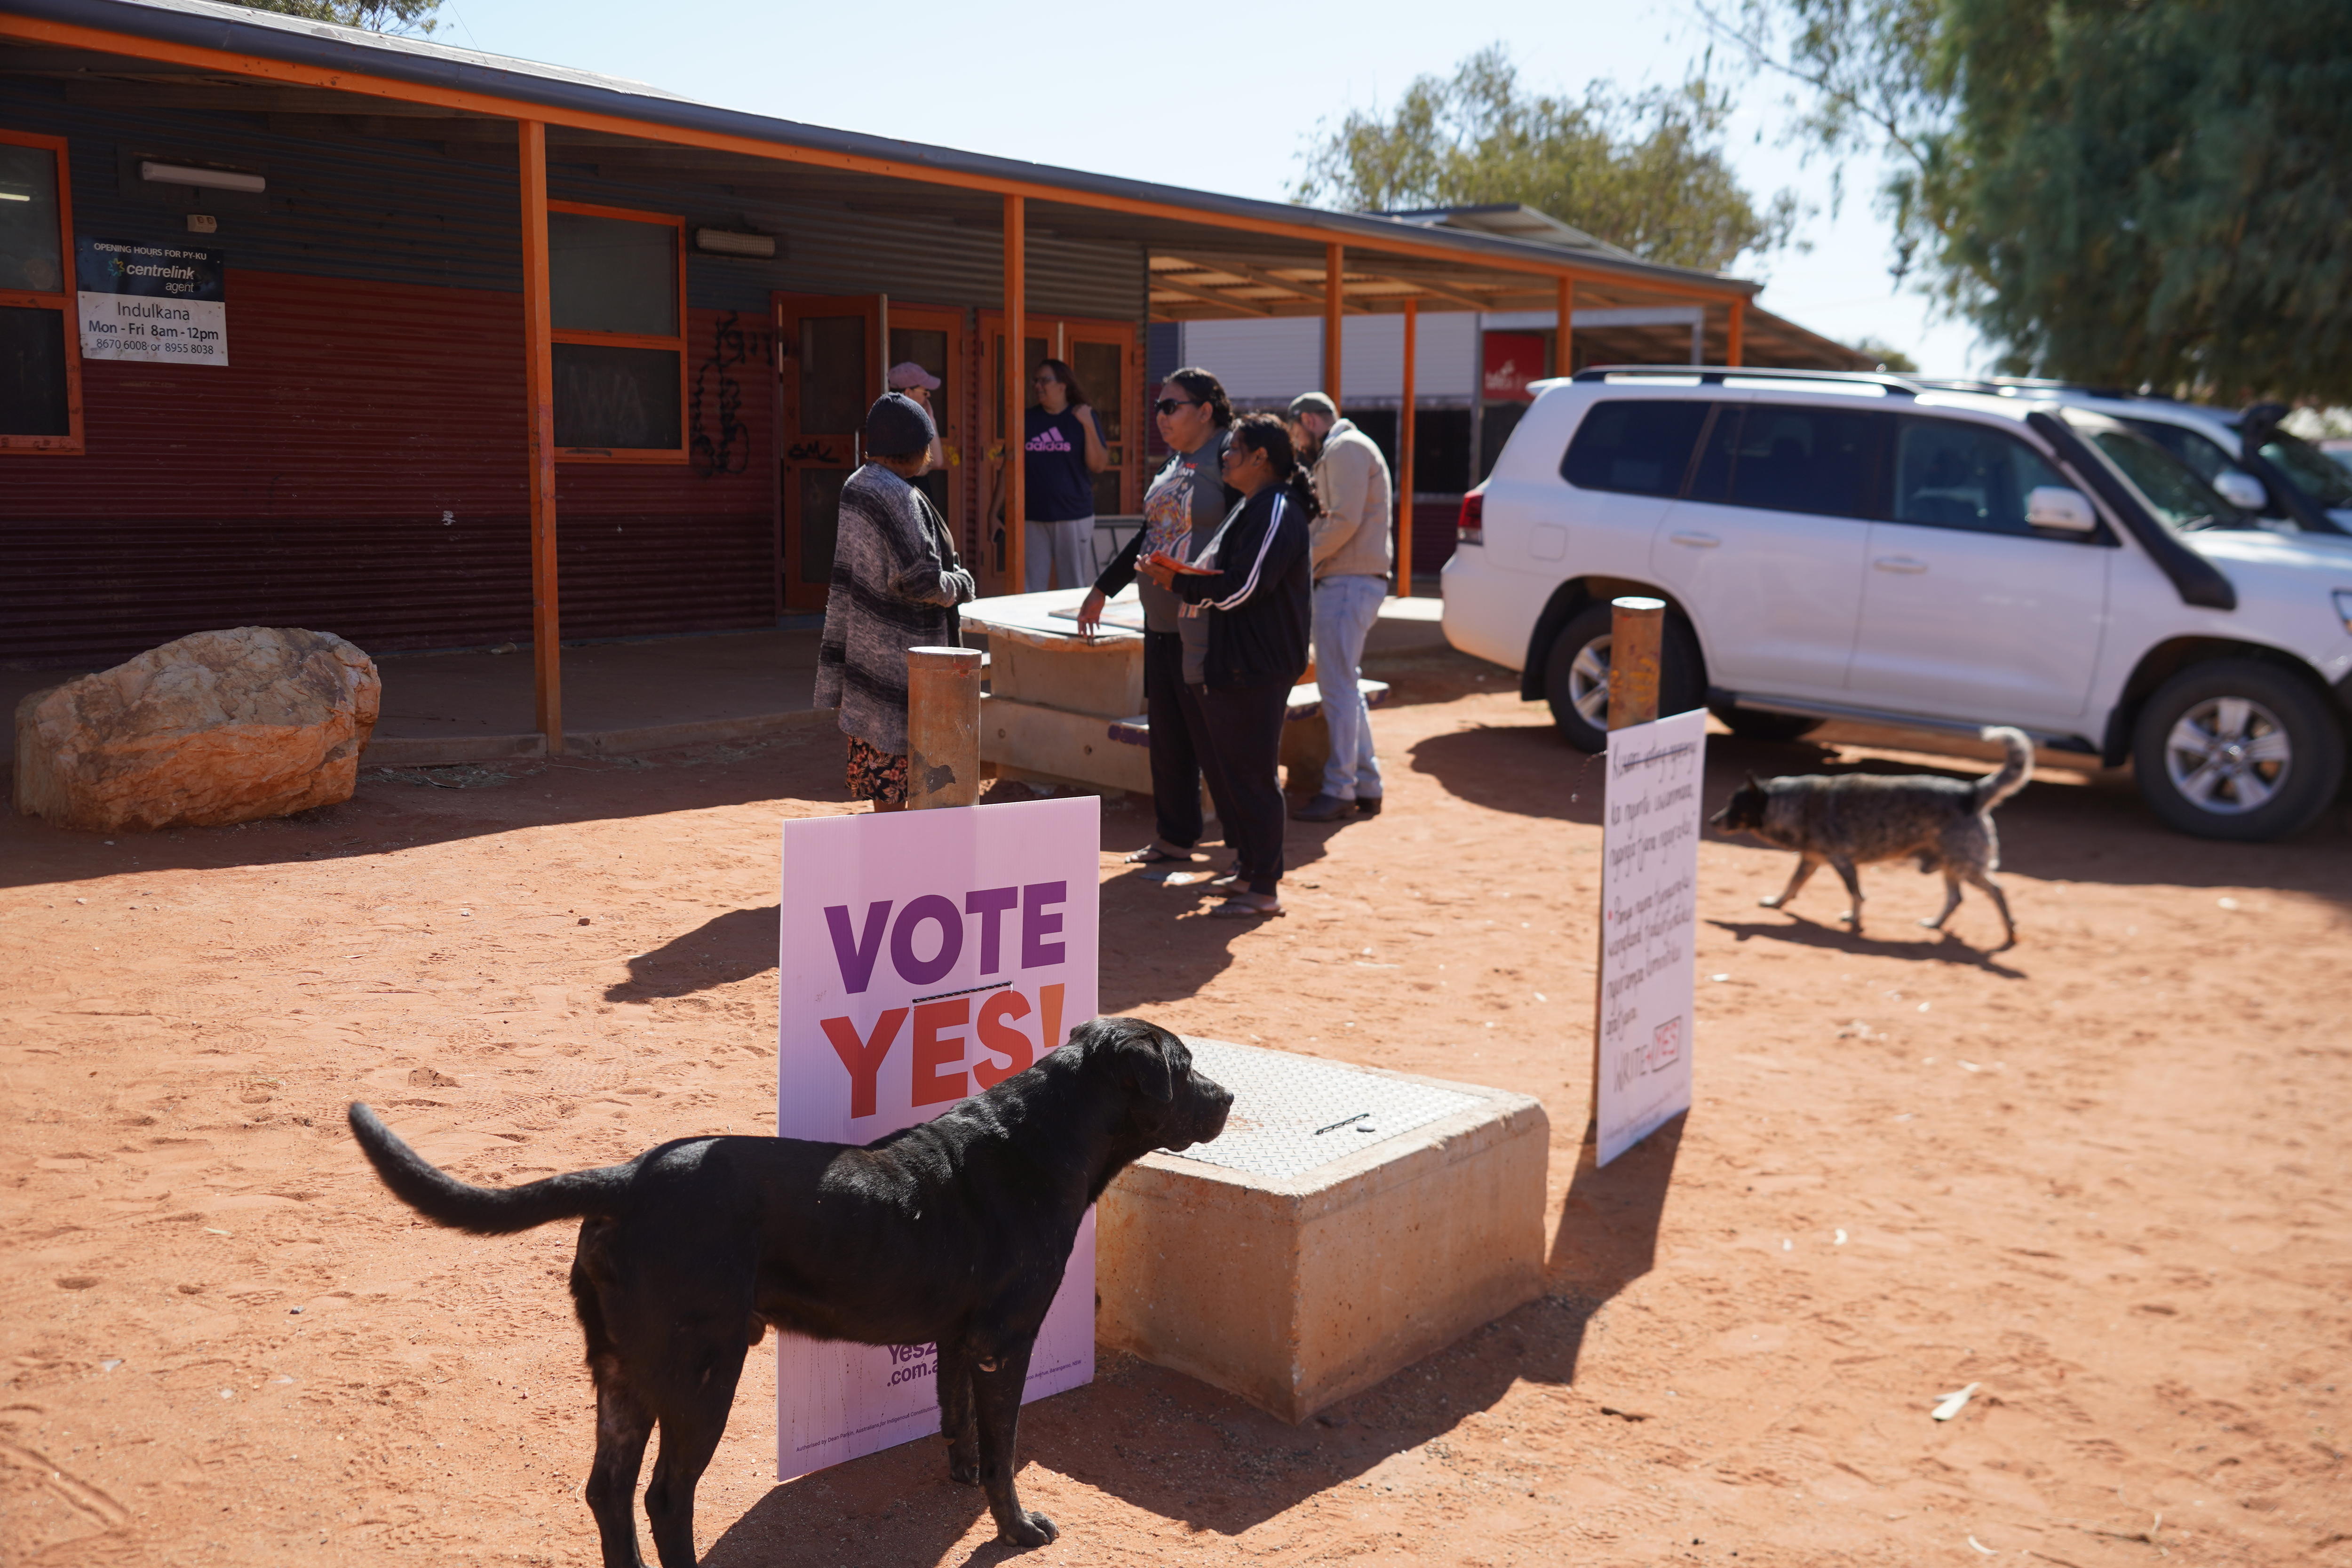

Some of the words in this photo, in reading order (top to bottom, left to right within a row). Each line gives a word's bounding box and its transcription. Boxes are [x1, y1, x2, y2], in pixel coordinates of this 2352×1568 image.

[94, 242, 132, 253] OPENING
[134, 247, 162, 256] HOURS
[165, 249, 181, 258] FOR
[183, 252, 207, 260] PY-KU
[127, 264, 195, 279] centrelink
[166, 282, 194, 294] agent
[118, 302, 190, 320] Indulkana
[89, 320, 117, 333] Mon
[129, 323, 144, 335] Fri
[151, 325, 178, 337] 8am
[187, 327, 219, 342] 12pm
[97, 338, 121, 349] 8670
[124, 340, 147, 350] 6008
[165, 342, 188, 353] 8955
[191, 344, 214, 354] 8038
[1025, 440, 1071, 452] adidas
[824, 880, 1066, 995] VOTE
[820, 983, 1065, 1119] YES!
[796, 1441, 820, 1452] Authorised
[855, 1423, 880, 1434] Australians
[887, 1414, 910, 1424] Indigenous
[911, 1404, 938, 1417] Constitutional
[1049, 1363, 1072, 1373] Barangaroo,
